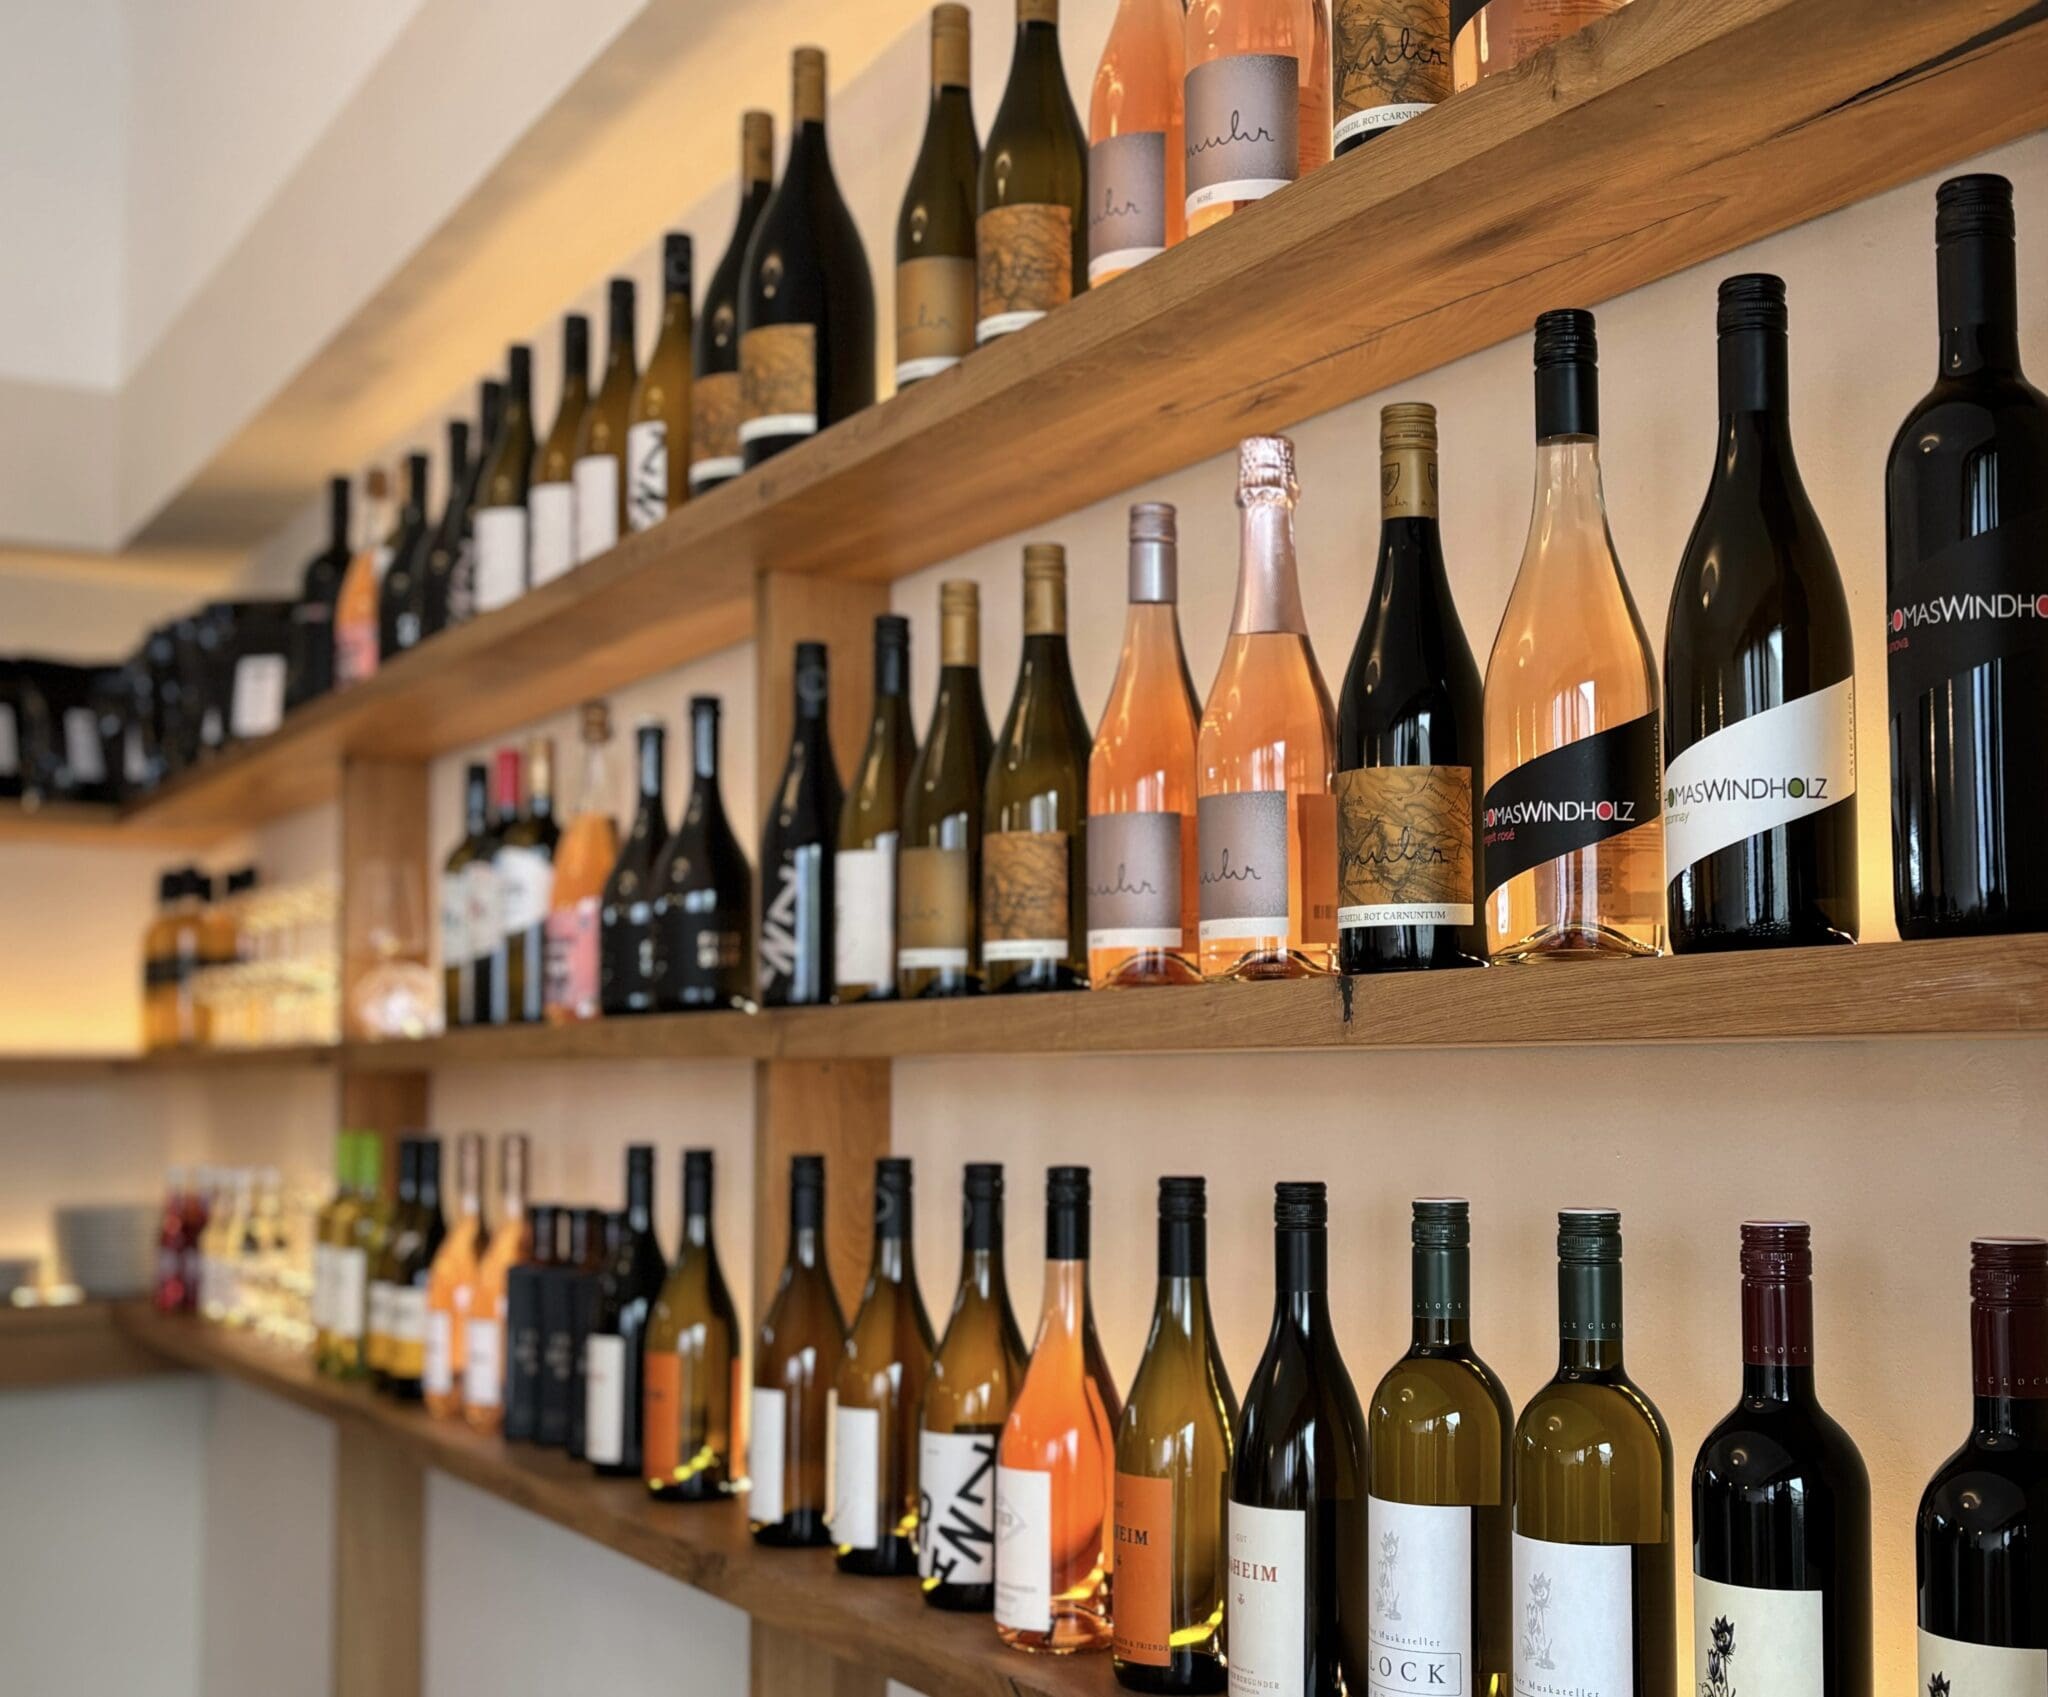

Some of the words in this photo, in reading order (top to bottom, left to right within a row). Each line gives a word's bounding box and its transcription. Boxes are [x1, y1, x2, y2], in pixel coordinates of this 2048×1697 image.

[1362, 115, 1381, 127] ROT
[1187, 109, 1275, 159] muhr
[1364, 911, 1382, 921] ROT
[1383, 910, 1447, 921] CARNUNTUM
[1230, 1558, 1278, 1583] HEIM
[1379, 1630, 1441, 1648] Muskateller
[1369, 1649, 1447, 1685] LOCK
